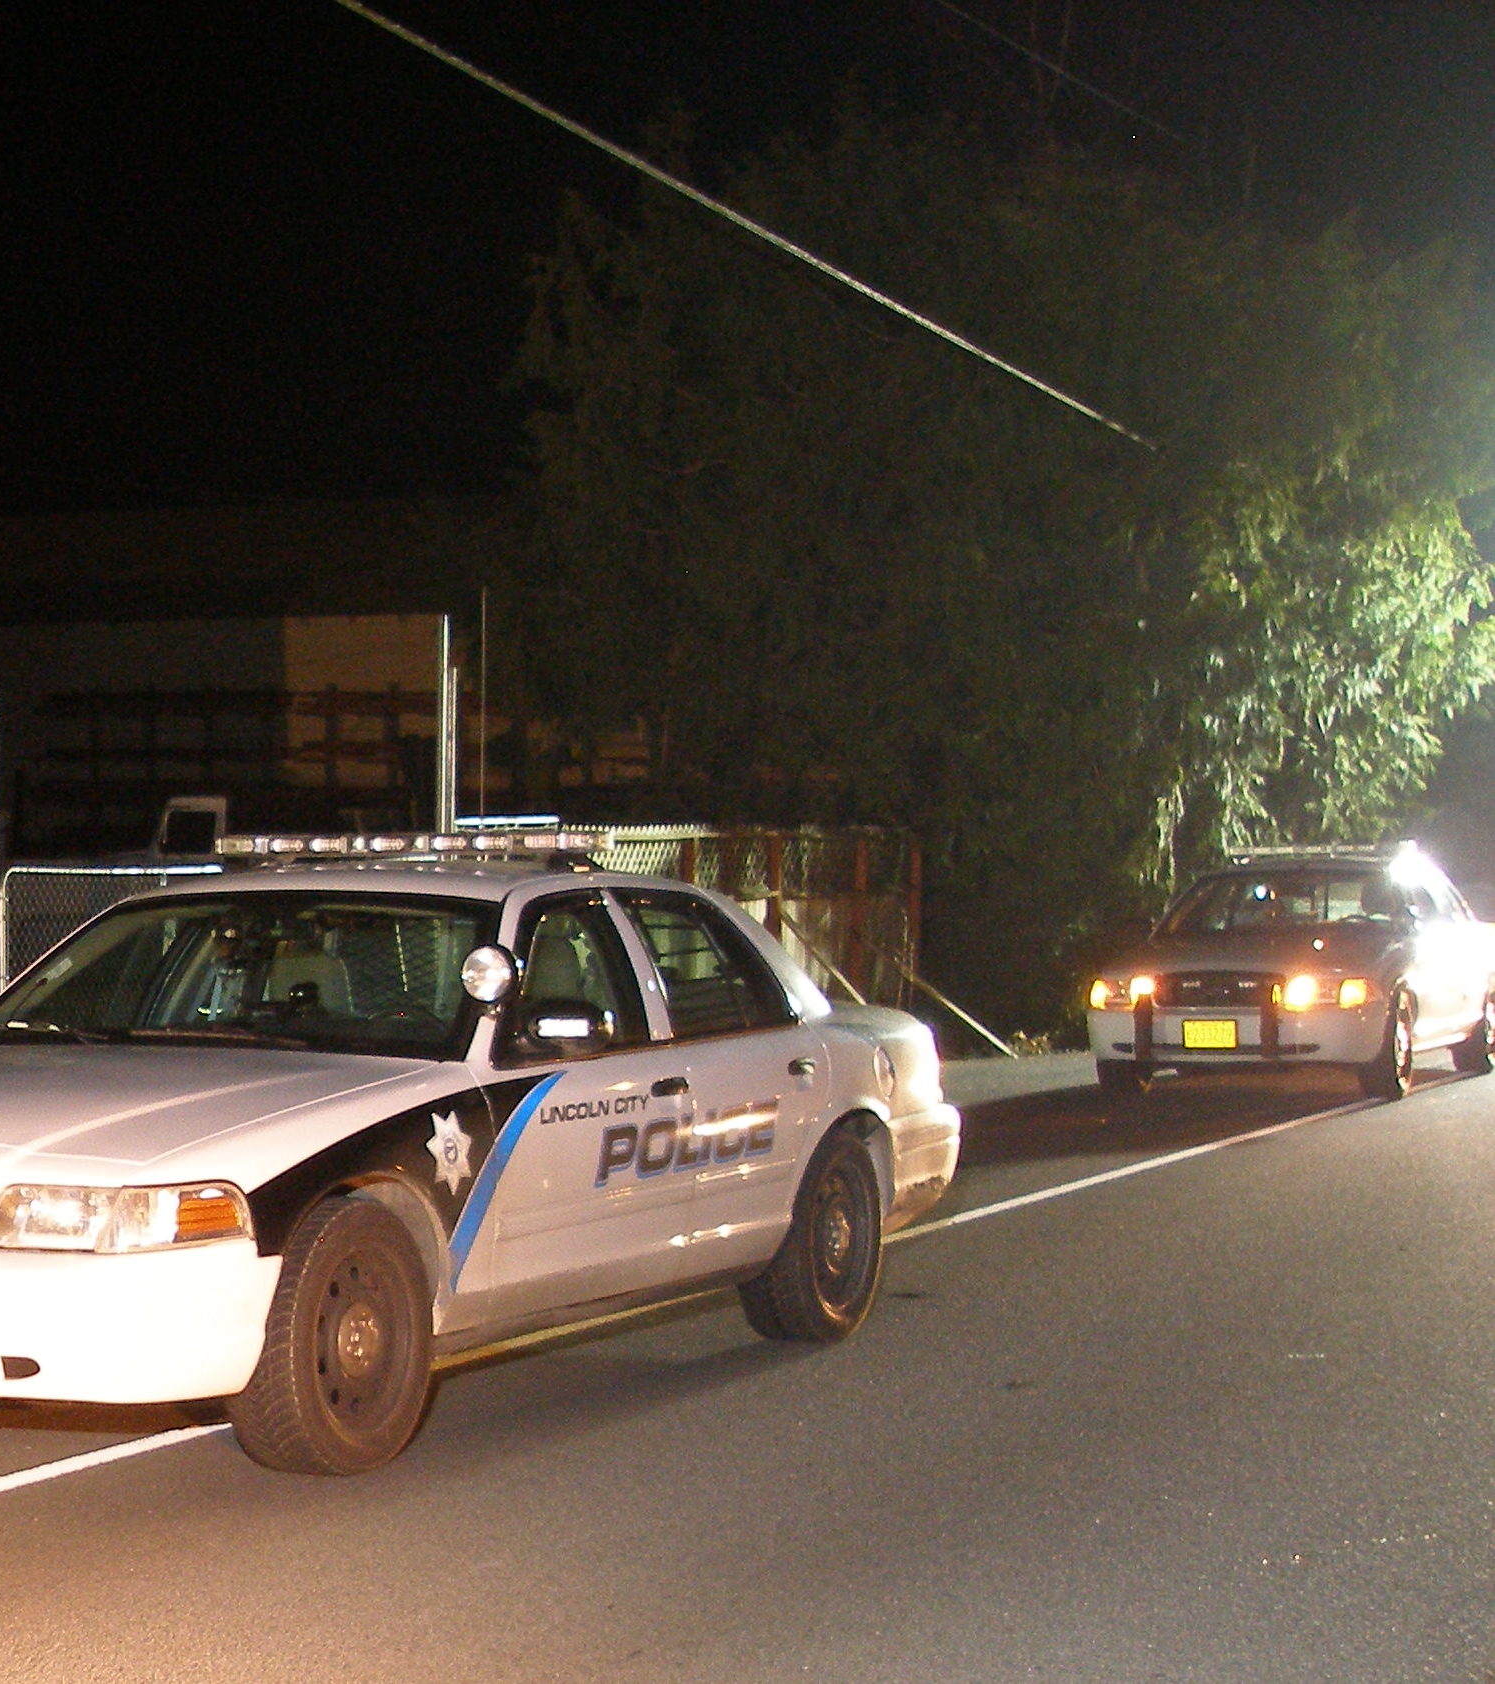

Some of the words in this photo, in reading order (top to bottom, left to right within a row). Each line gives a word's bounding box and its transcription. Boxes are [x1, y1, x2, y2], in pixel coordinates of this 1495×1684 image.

[540, 1100, 609, 1125] LINCOLN
[614, 1095, 649, 1114] CITY
[594, 1100, 779, 1188] POLICE
